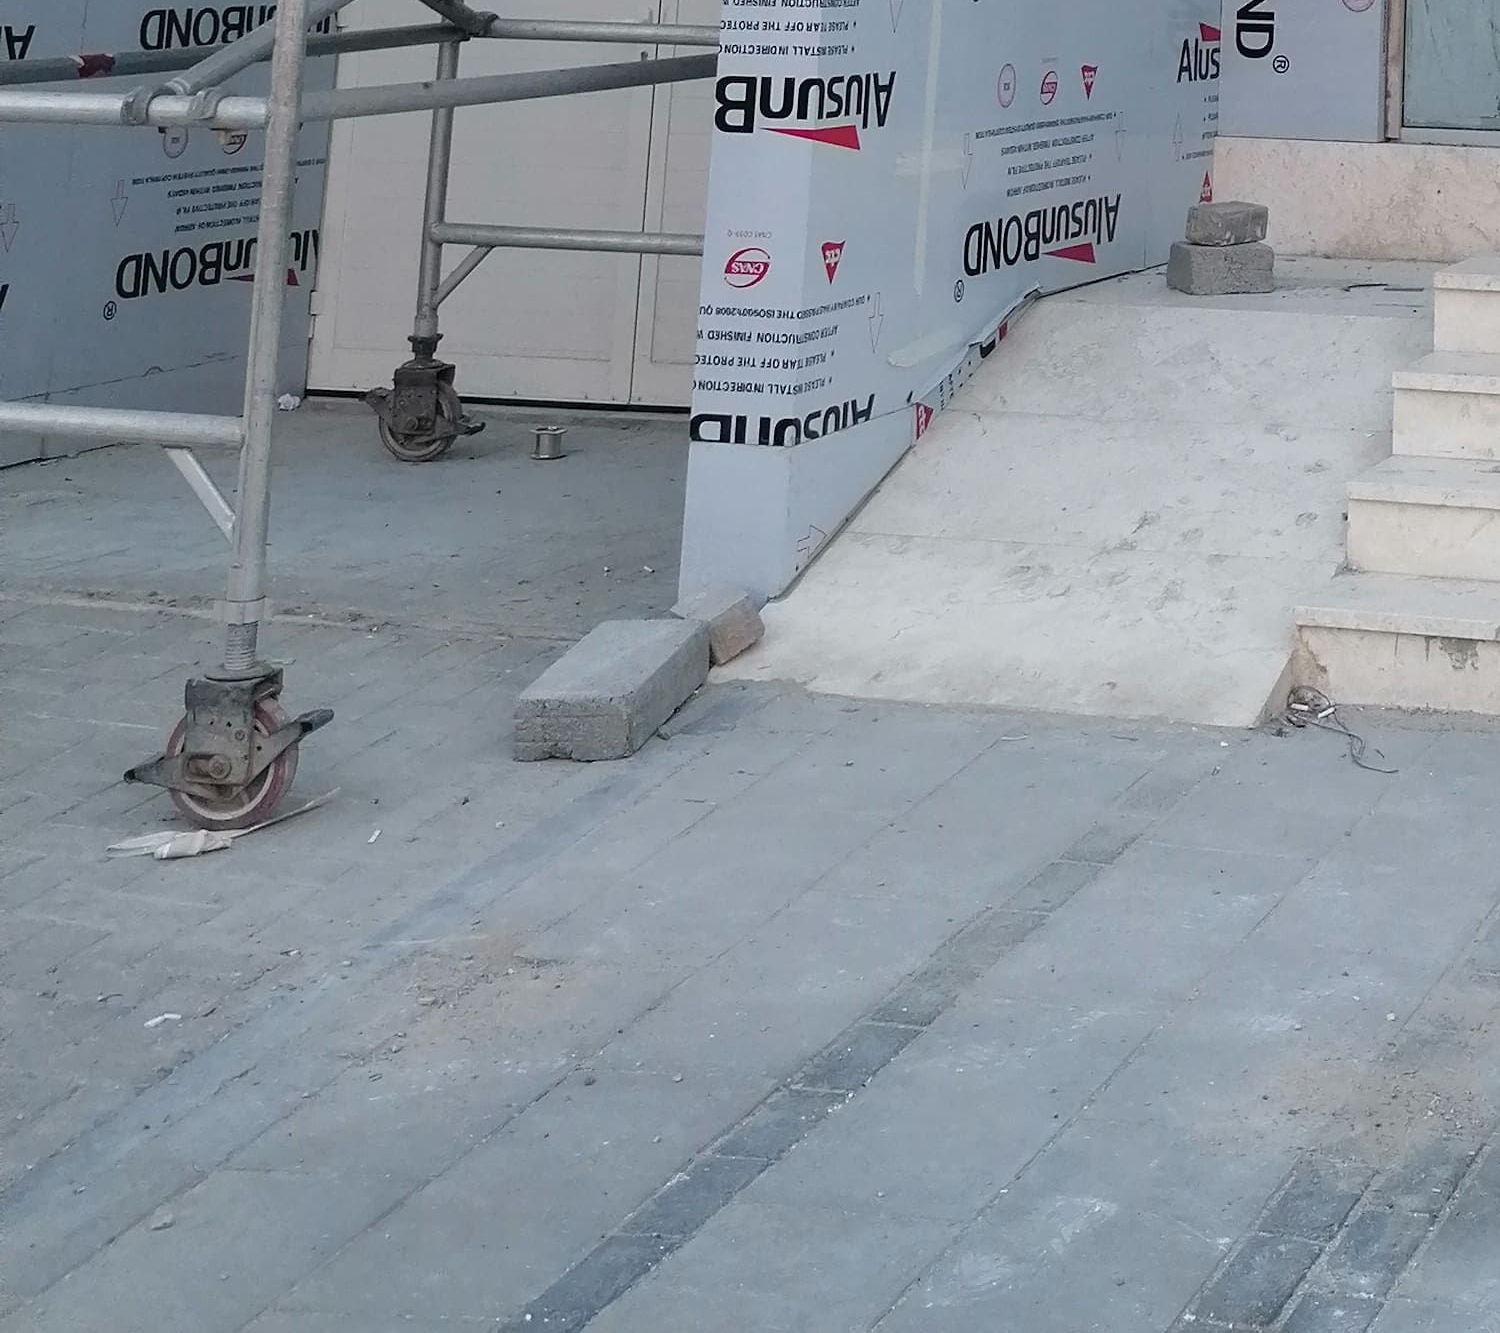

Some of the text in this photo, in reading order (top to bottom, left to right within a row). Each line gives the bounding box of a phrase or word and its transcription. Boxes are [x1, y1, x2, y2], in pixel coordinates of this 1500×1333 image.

[715, 70, 897, 134] AlusunB
[963, 194, 1122, 278] AlusunBOND
[737, 355, 757, 368] THE
[760, 357, 780, 369] OFF
